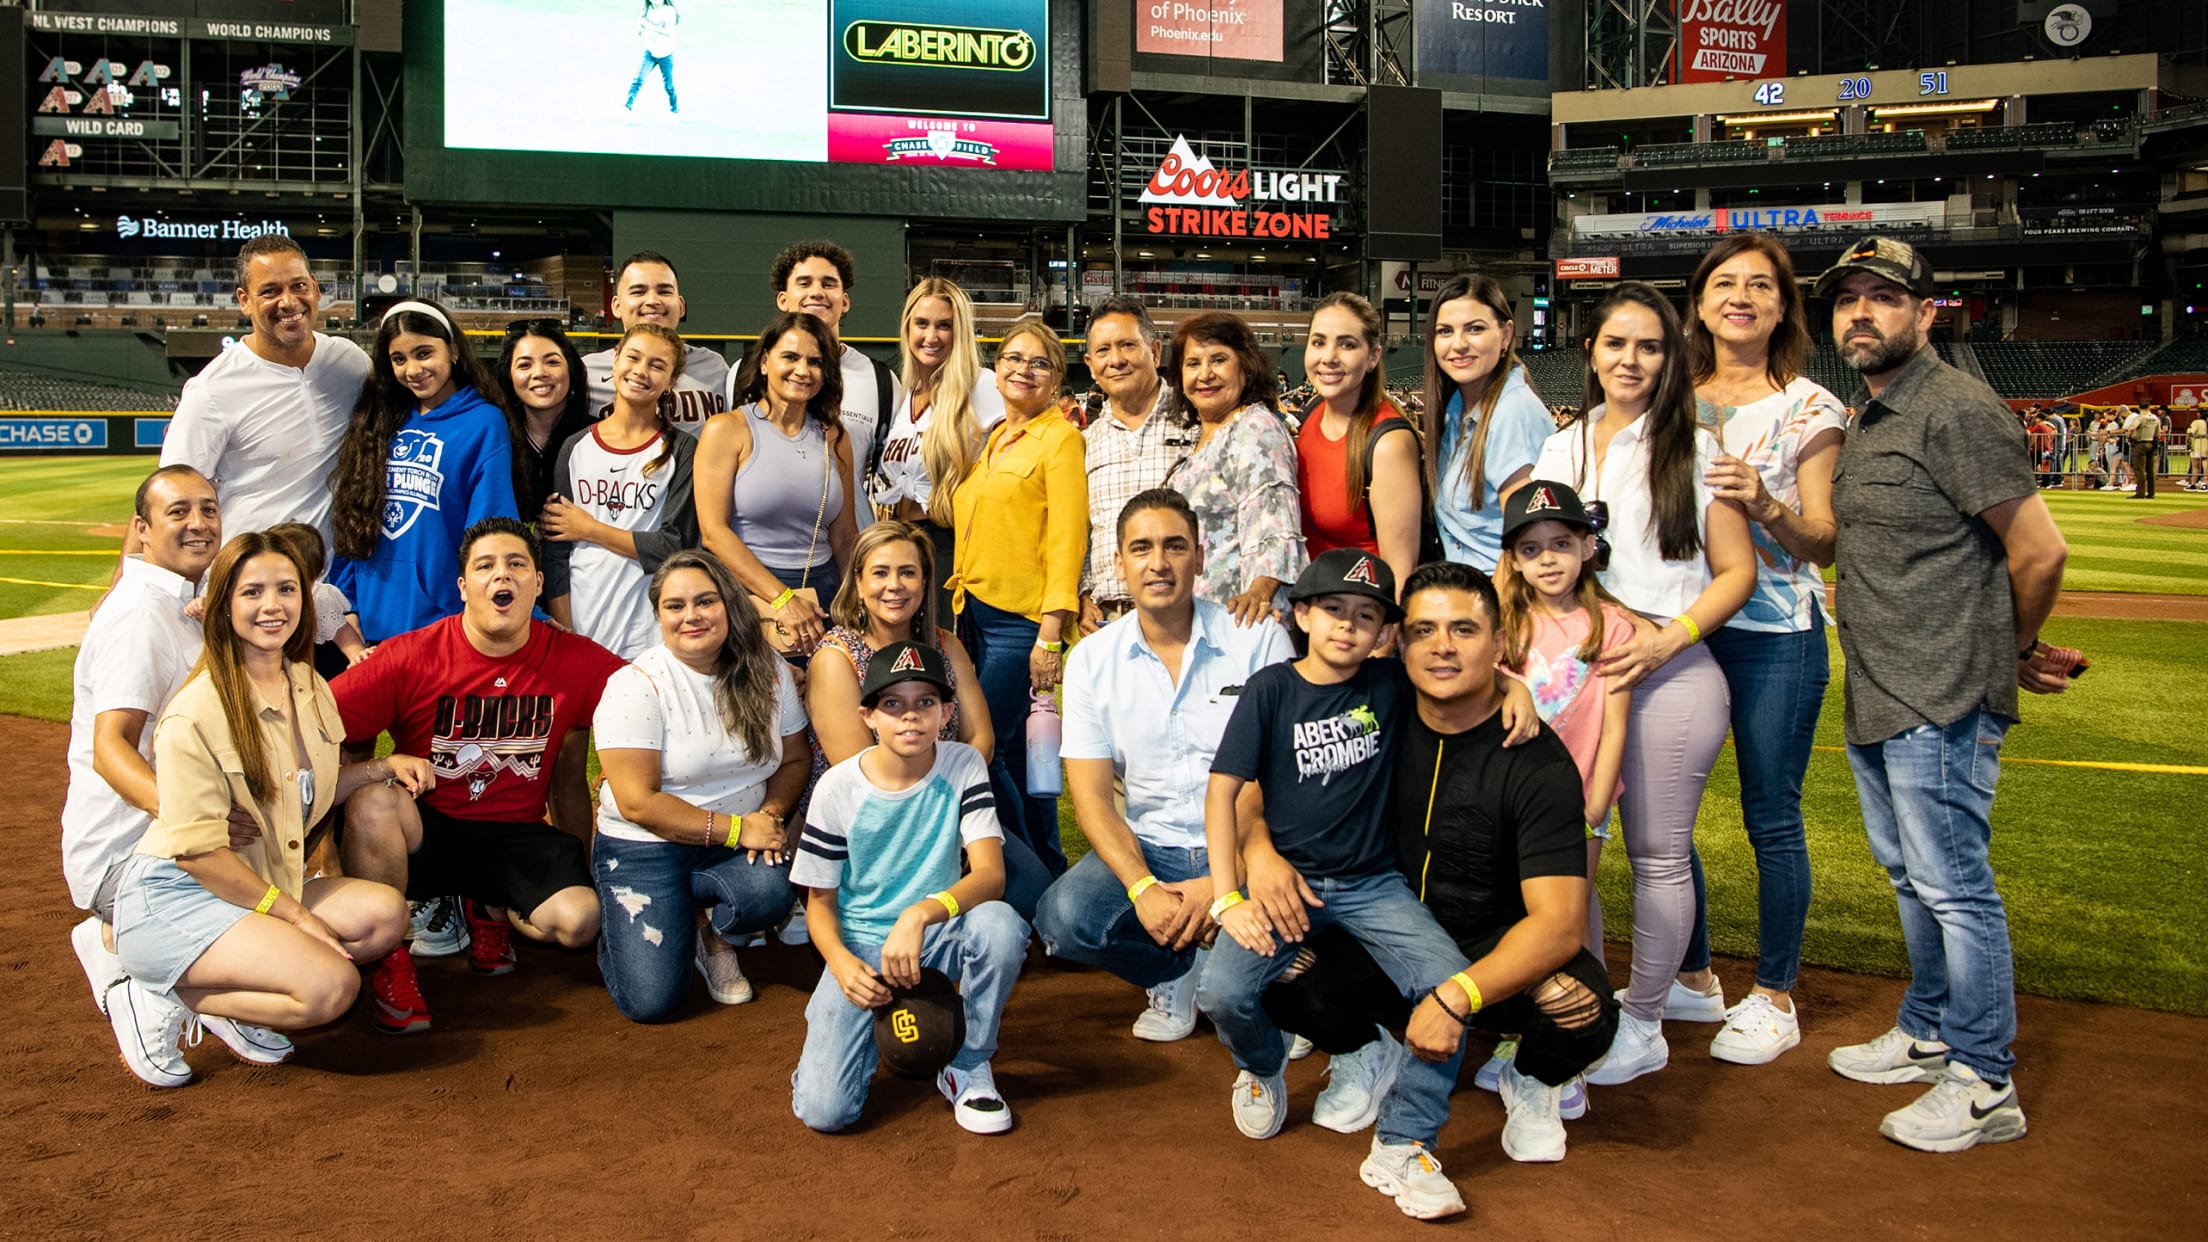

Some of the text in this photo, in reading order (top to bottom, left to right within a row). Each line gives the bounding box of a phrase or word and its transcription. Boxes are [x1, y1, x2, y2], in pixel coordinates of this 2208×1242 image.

[32, 14, 178, 34] NL WEST CHAMPIONS
[1151, 1, 1245, 25] of Phoenix
[207, 23, 331, 41] WORLD CHAMPIONS
[1151, 25, 1223, 42] Phoenix.edu
[1699, 26, 1757, 50] SPORTS
[857, 25, 1030, 66] LABERINTO
[1700, 51, 1756, 72] ARIZONA
[1754, 81, 1784, 105] 42
[1838, 76, 1872, 100] 20
[1920, 72, 1949, 96] 51
[66, 120, 144, 136] WILD CARD
[907, 120, 976, 132] WELCOME TO
[894, 142, 989, 154] CHASE FIELD
[1148, 153, 1341, 202] Coors LIGHT
[142, 218, 289, 239] Banner Health
[1148, 207, 1330, 239] STRIKE ZONE
[1640, 208, 1873, 231] Michelob ULTRA TERRACE
[1809, 236, 1845, 246] ULTRA
[1590, 265, 1617, 274] METER
[841, 410, 873, 424] SSENTIALS
[0, 425, 71, 442] CHASE
[393, 473, 437, 497] PLUNGE
[577, 479, 657, 511] D-BACKS
[433, 694, 555, 740] D-BACKS
[1293, 716, 1348, 750] ABER
[1296, 730, 1381, 775] CROMBIE
